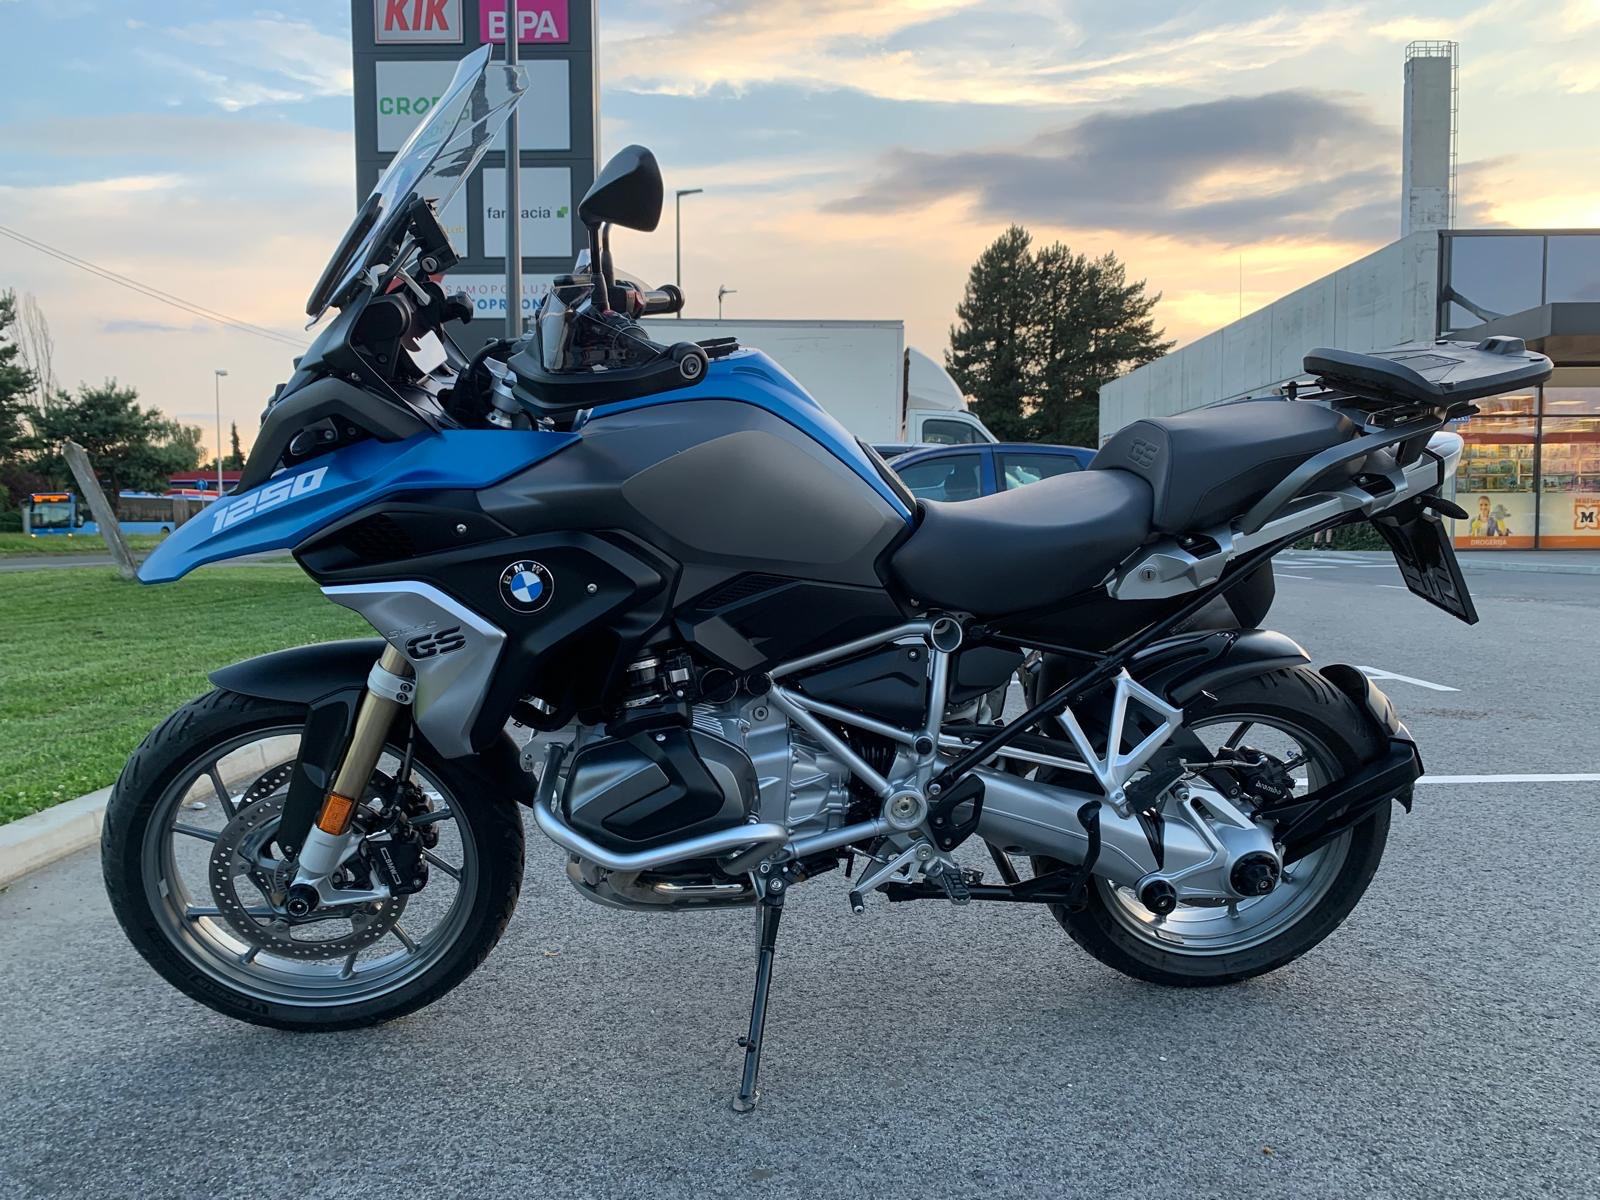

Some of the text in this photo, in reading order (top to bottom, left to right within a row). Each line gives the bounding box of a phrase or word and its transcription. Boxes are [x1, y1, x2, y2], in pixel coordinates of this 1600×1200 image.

[488, 10, 559, 39] BPA
[487, 207, 551, 219] faracia
[211, 466, 329, 534] 1250
[503, 563, 543, 585] BMW
[405, 625, 466, 661] GS
